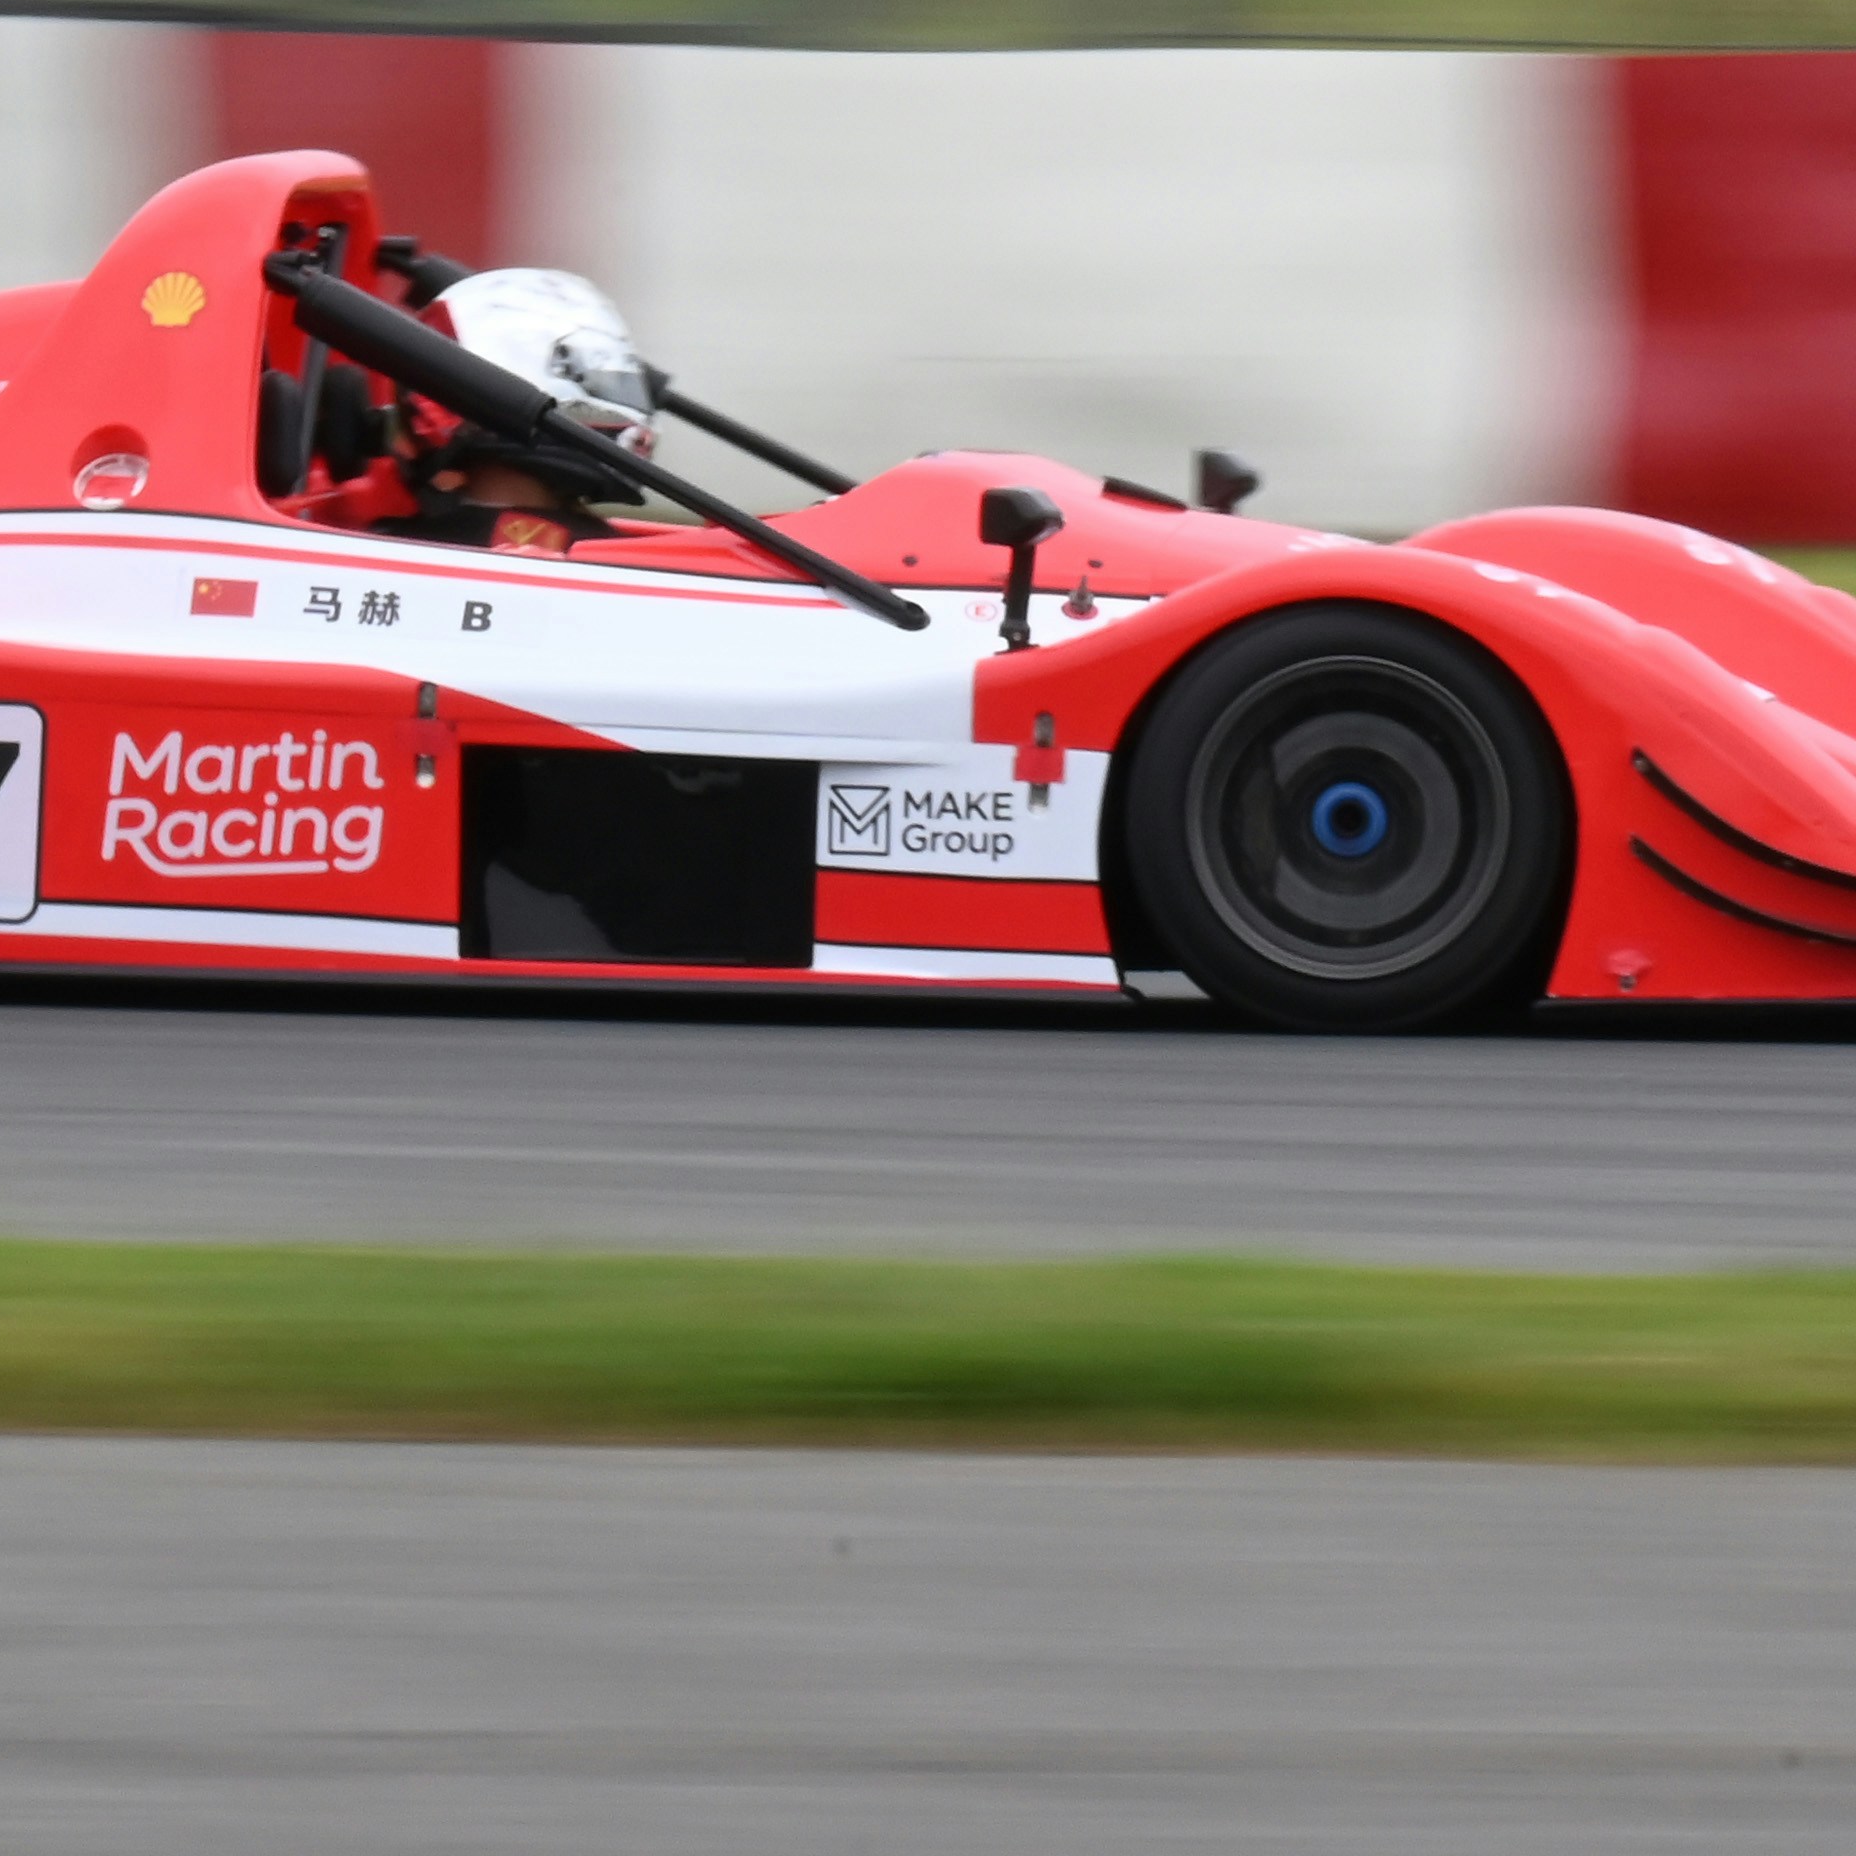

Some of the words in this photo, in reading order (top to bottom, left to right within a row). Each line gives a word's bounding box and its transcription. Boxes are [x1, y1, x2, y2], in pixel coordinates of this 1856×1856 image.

[303, 586, 401, 627] 马赫
[461, 601, 494, 632] B
[108, 729, 384, 796] Martin
[903, 791, 1014, 821] MAKE
[101, 792, 385, 878] Racing
[902, 824, 1015, 862] Group
